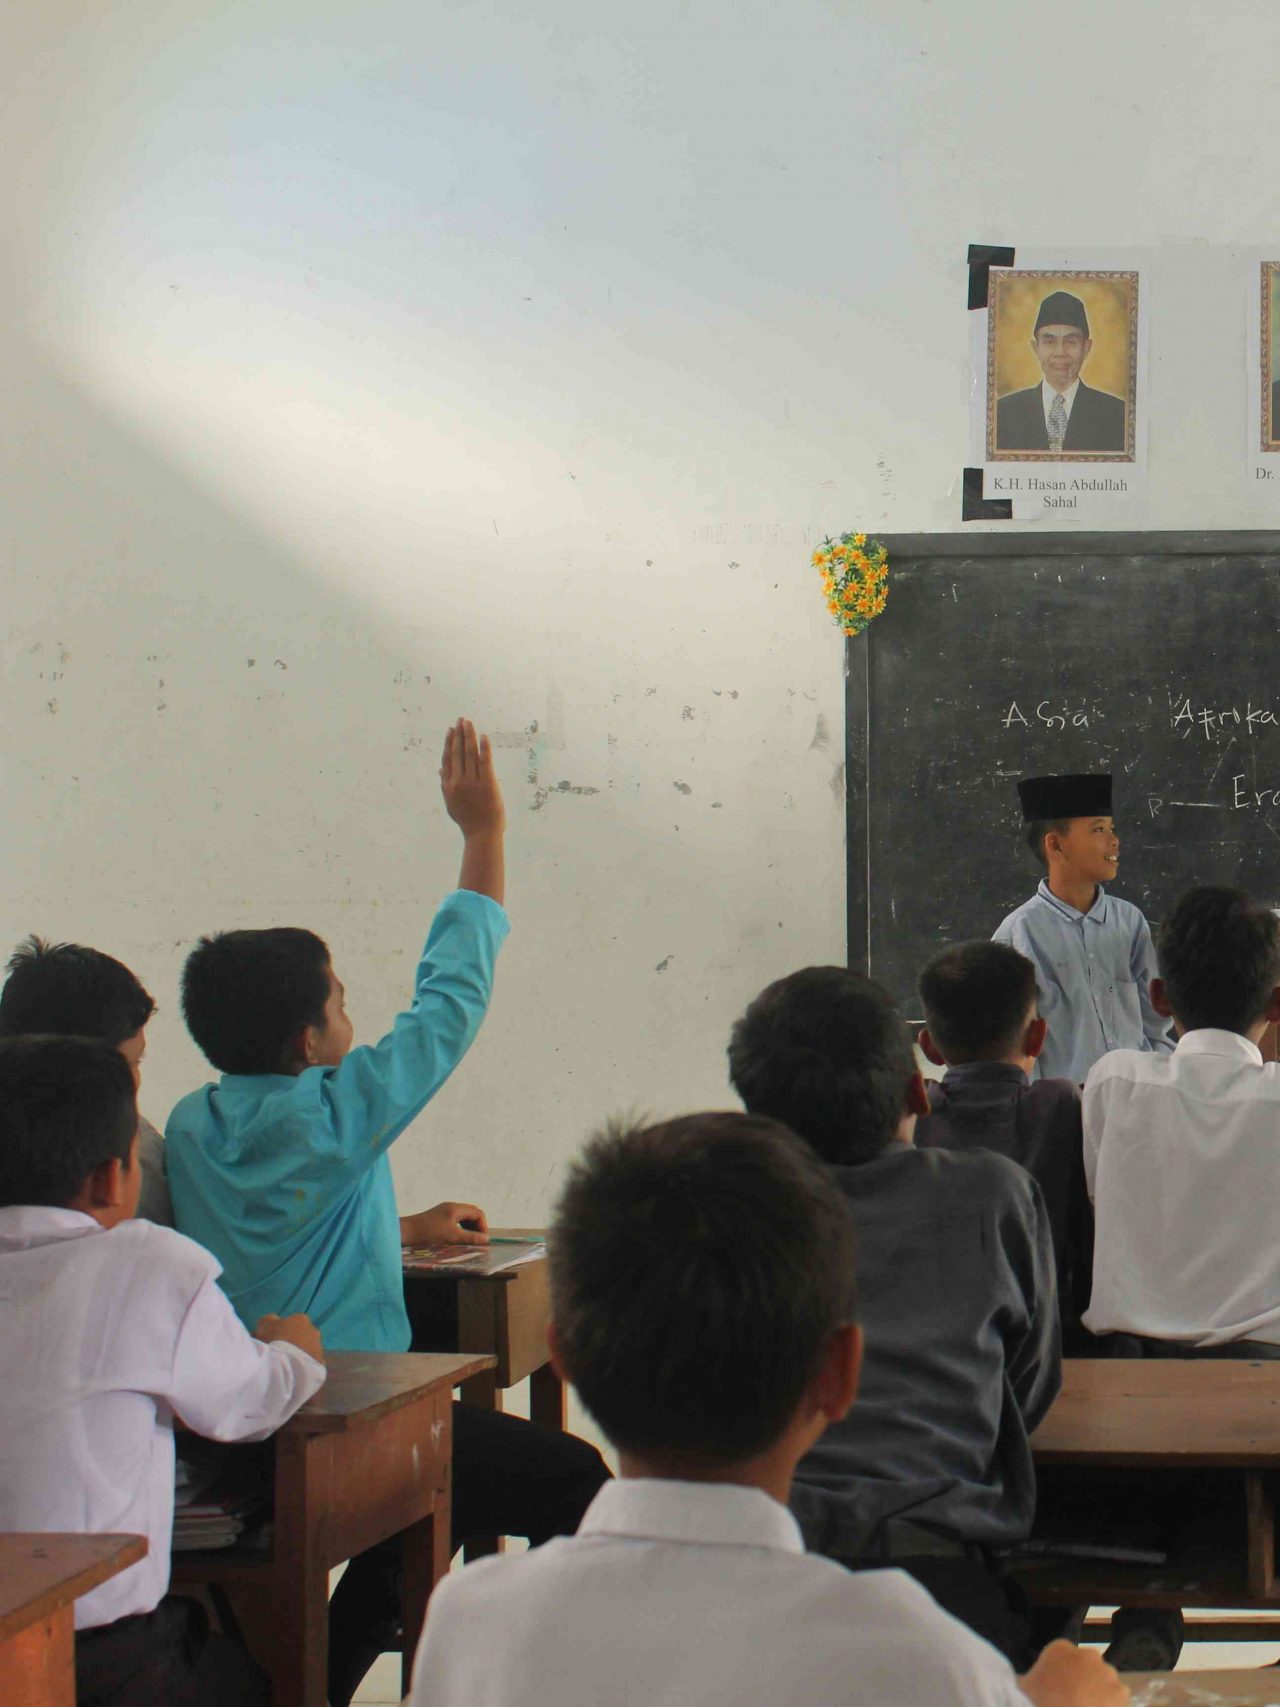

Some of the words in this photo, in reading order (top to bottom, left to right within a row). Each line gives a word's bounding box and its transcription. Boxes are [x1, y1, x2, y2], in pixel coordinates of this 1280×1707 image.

[1255, 467, 1274, 480] Dr.
[994, 478, 1024, 490] K.H.
[1028, 478, 1066, 490] Hasan
[1070, 479, 1128, 491] Abdullah
[1043, 495, 1077, 508] Sahal
